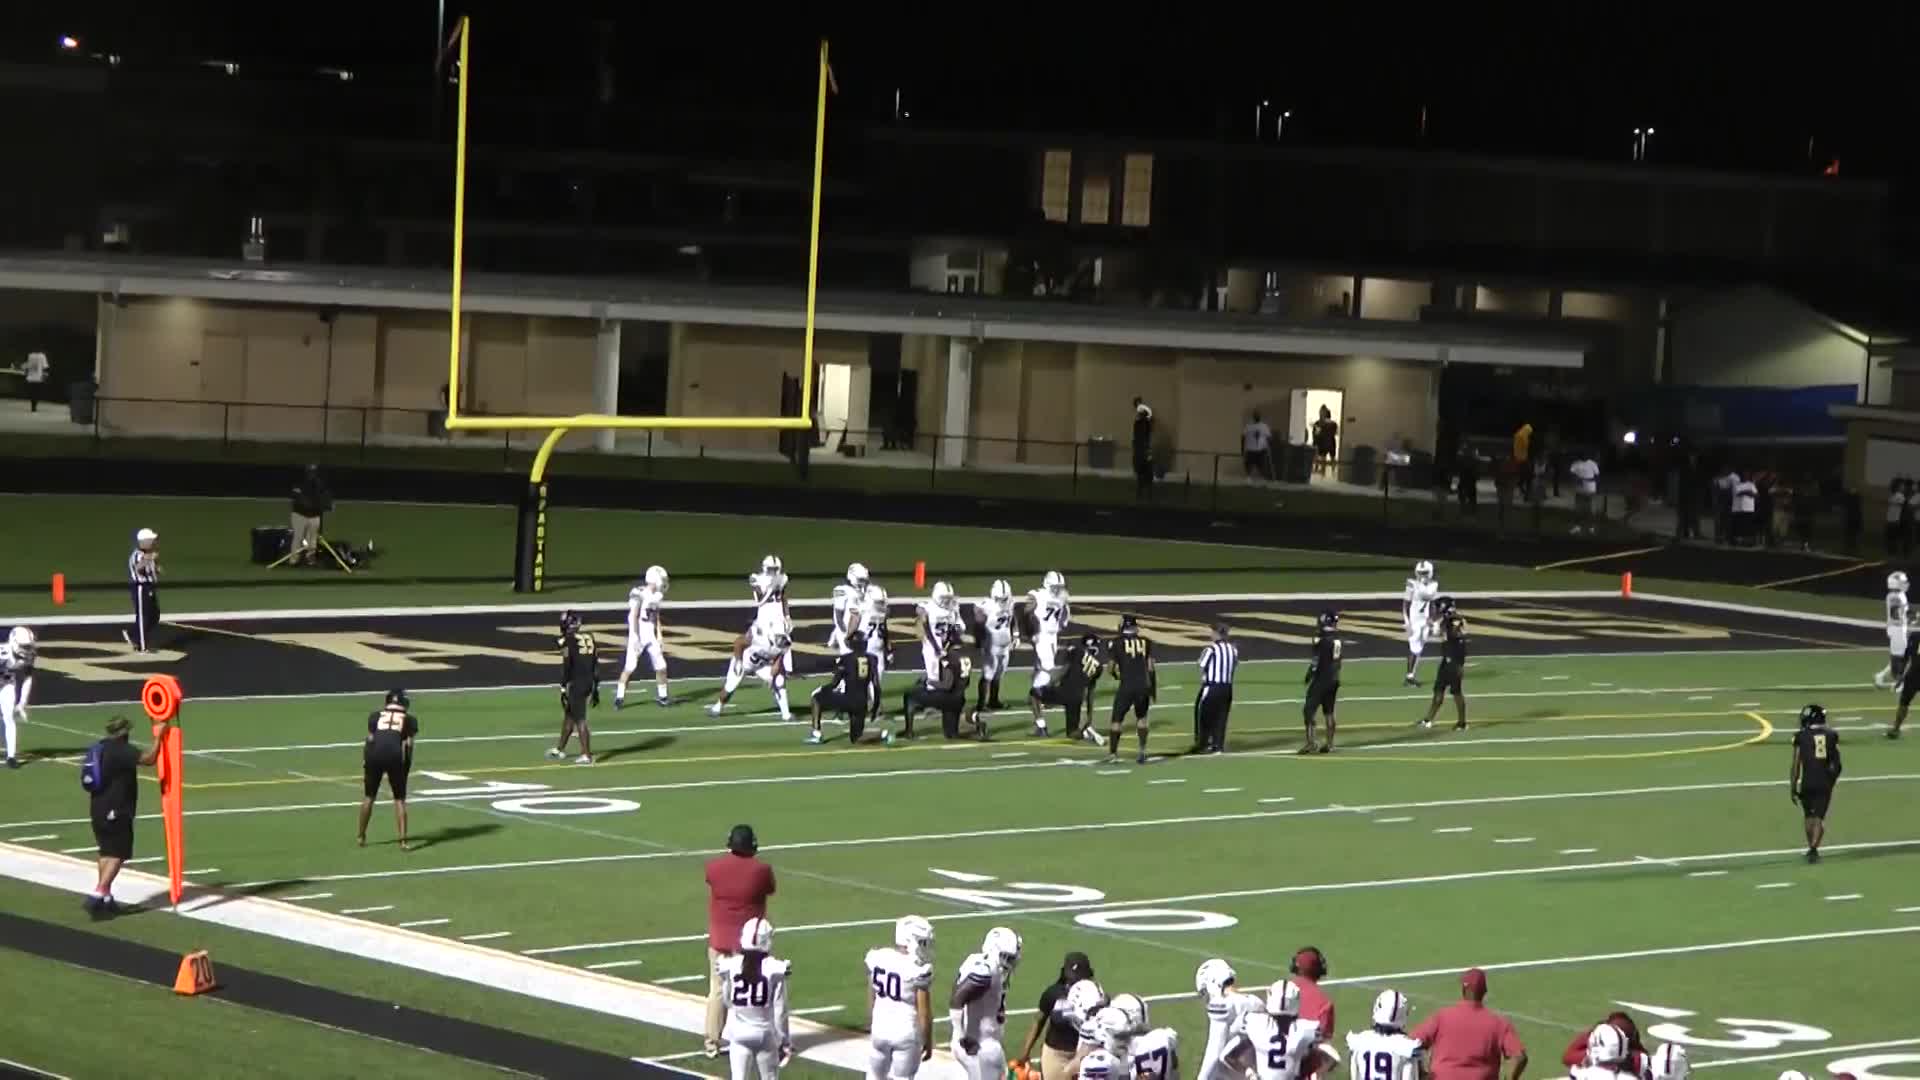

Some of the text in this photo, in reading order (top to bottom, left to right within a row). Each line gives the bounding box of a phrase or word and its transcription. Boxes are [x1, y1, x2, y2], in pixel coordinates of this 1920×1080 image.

[1125, 639, 1146, 657] 44
[857, 656, 869, 679] 6
[377, 710, 405, 732] 25
[1813, 734, 1827, 759] 8
[190, 955, 213, 989] 20
[872, 966, 902, 1002] 50
[732, 973, 769, 1006] 20
[1268, 1034, 1288, 1069] 2
[1363, 1050, 1393, 1080] 19
